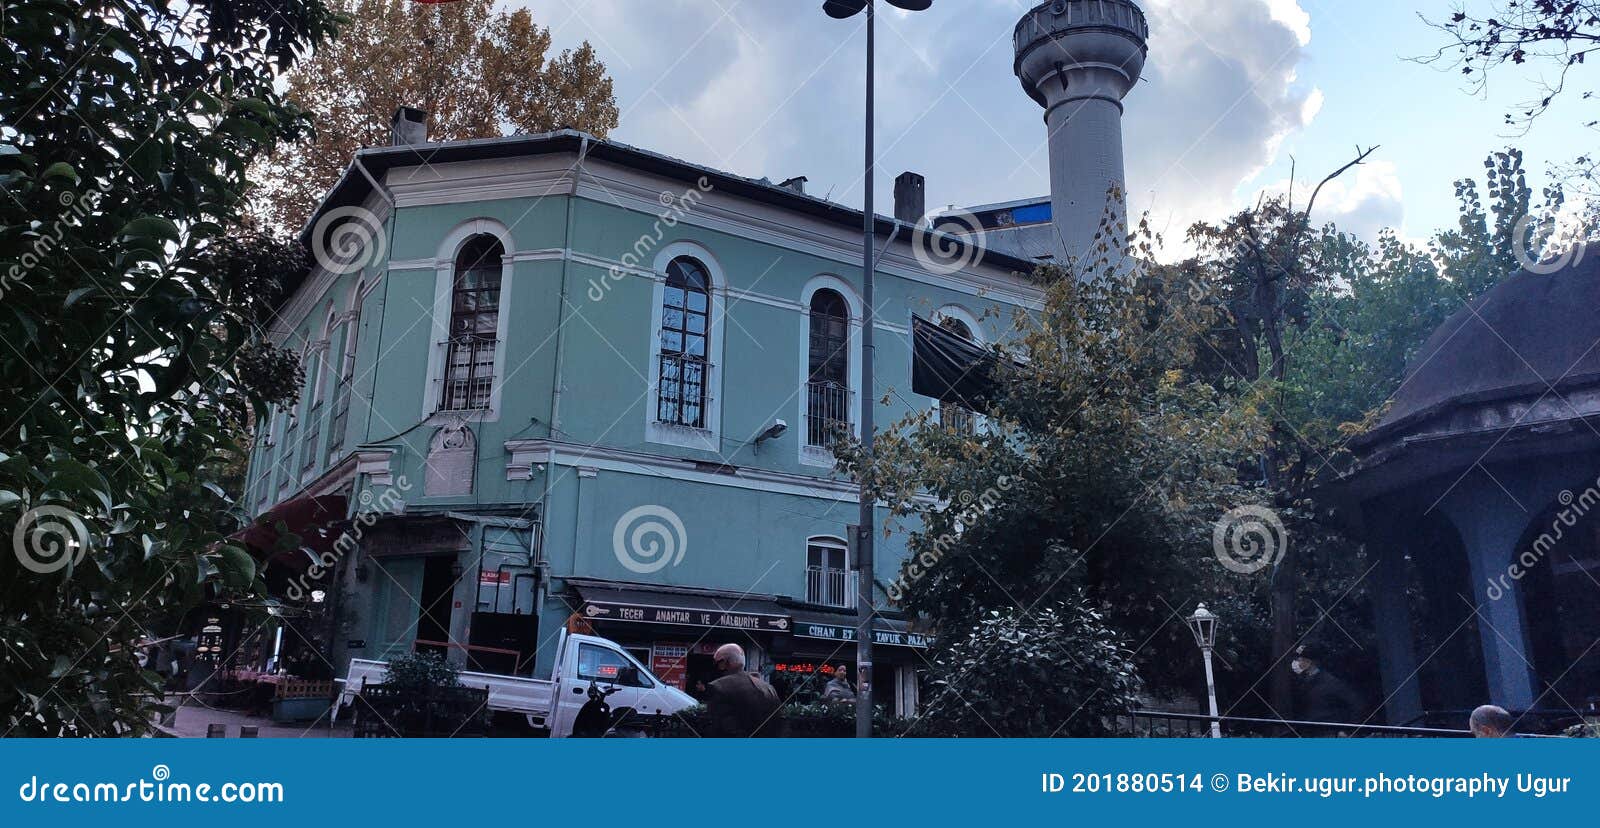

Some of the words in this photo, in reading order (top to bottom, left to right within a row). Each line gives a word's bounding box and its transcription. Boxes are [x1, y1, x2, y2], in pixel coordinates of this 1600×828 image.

[619, 607, 644, 620] TECER
[655, 610, 690, 623] ANAHTAR
[700, 614, 711, 625] VE
[808, 625, 836, 638] CİHAN
[842, 630, 854, 640] ET
[875, 632, 901, 644] TAVUK
